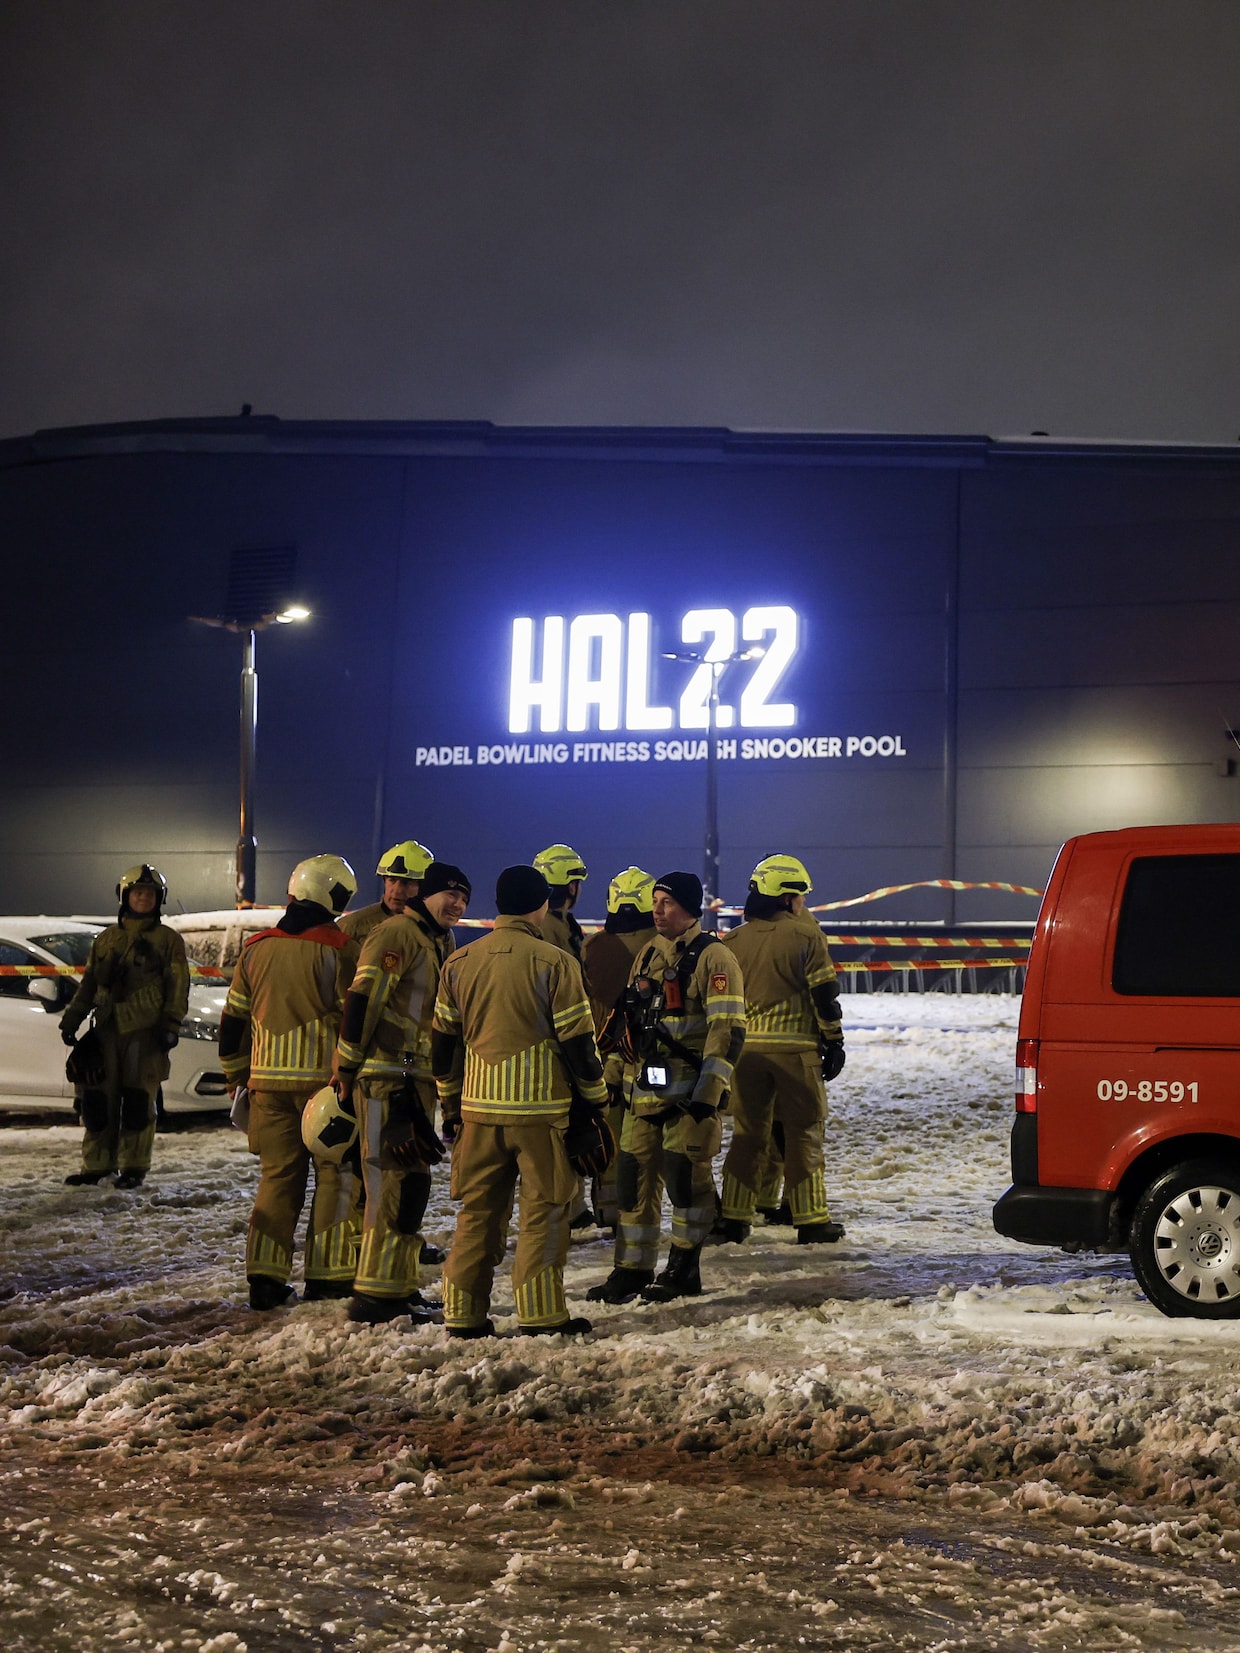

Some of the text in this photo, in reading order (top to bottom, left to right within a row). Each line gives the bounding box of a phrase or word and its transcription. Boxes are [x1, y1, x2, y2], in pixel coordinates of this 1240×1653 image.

[508, 606, 798, 733] HAL22
[415, 745, 473, 766] PADEL
[477, 743, 569, 765] BOWLING
[573, 741, 651, 763] FITNESS
[741, 737, 842, 760] SNOOKER
[846, 735, 907, 758] POOL
[1097, 1079, 1199, 1103] 09-8591
